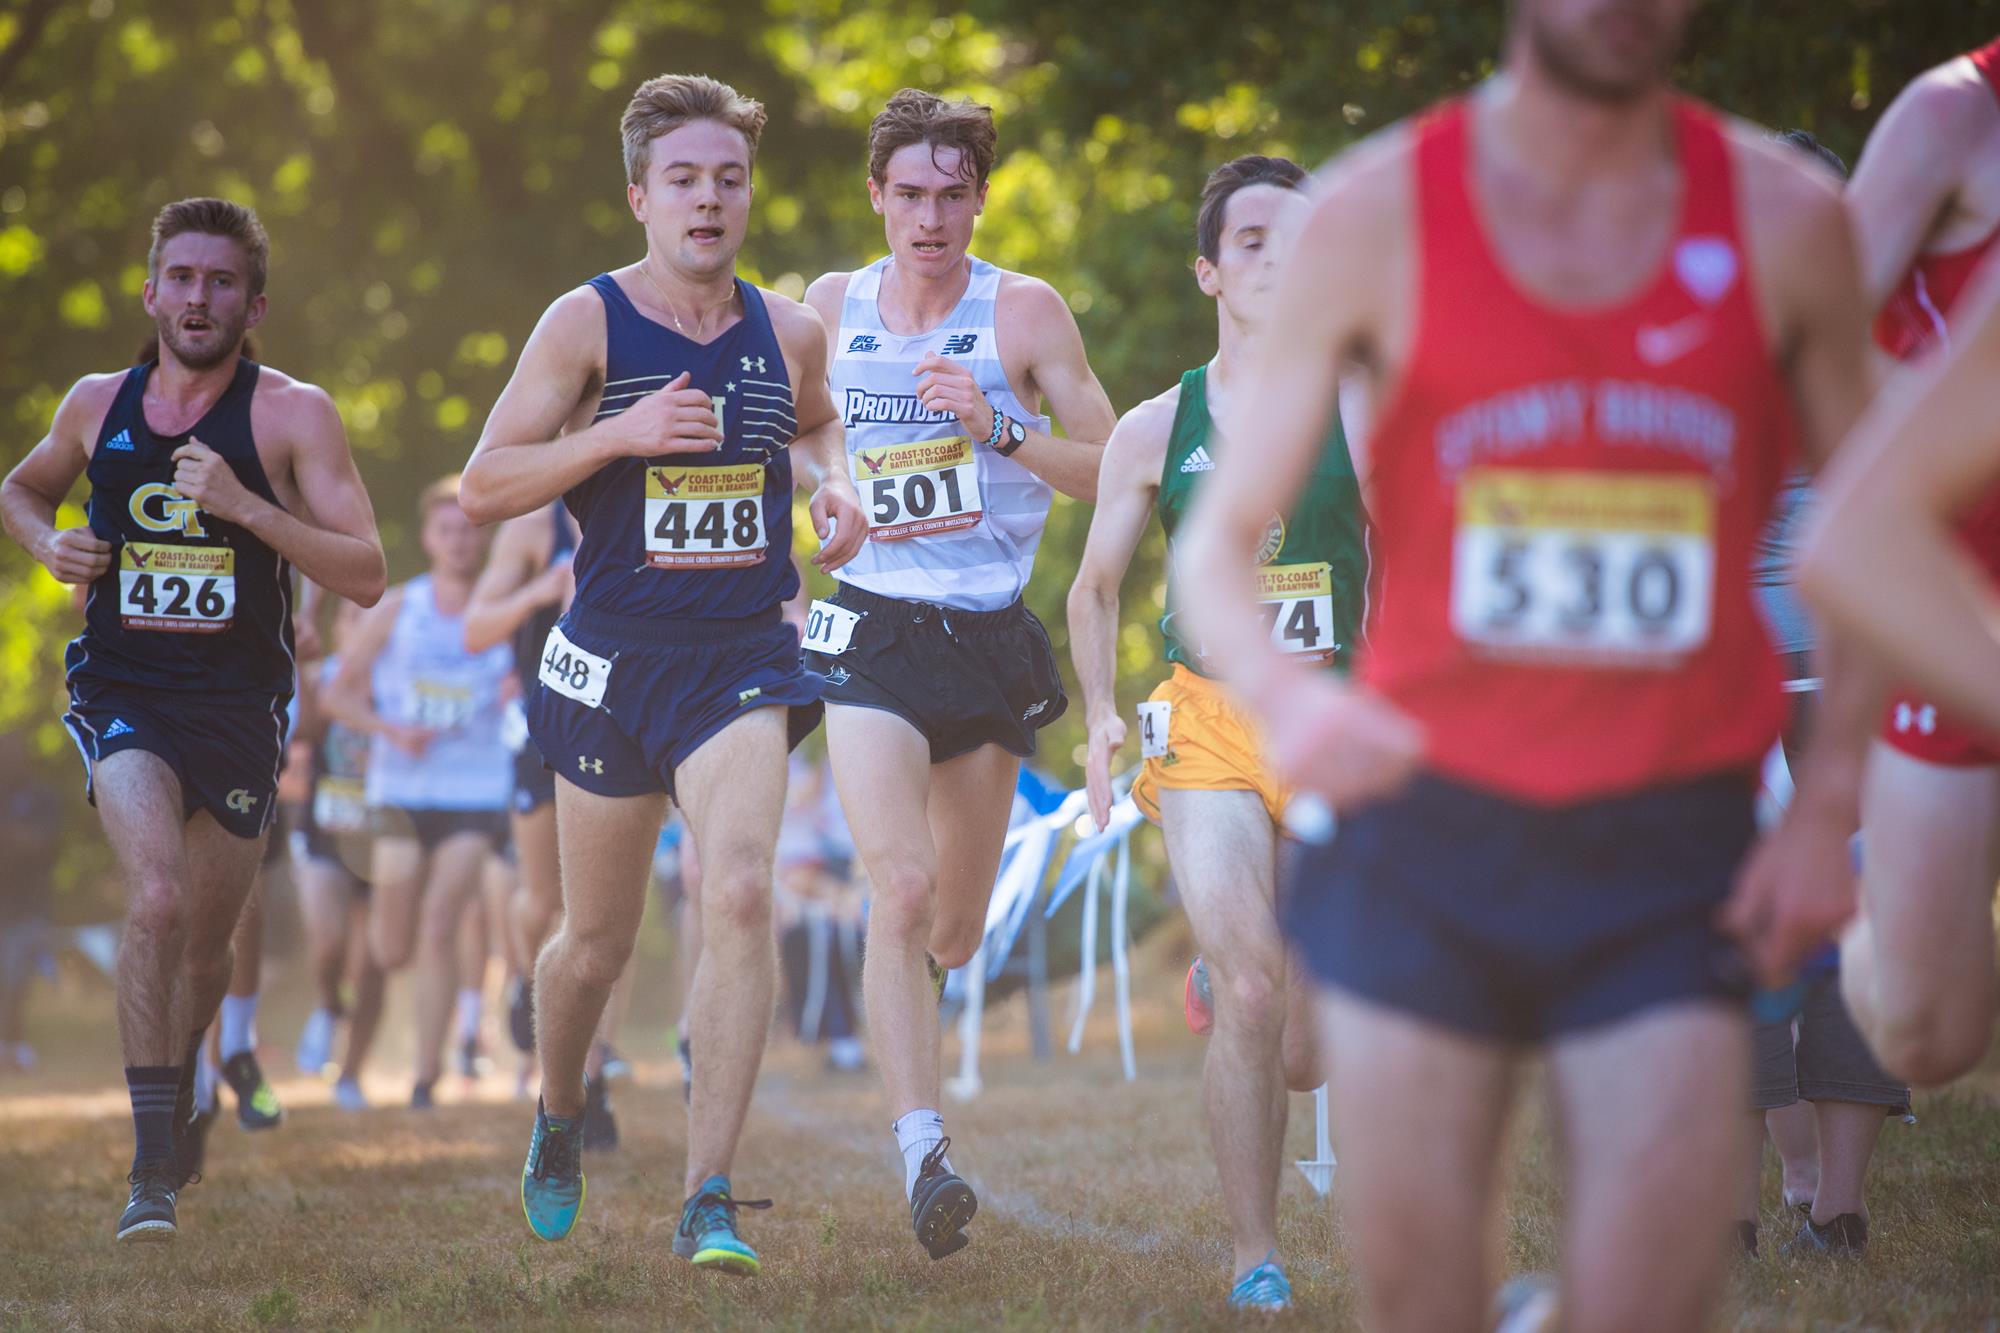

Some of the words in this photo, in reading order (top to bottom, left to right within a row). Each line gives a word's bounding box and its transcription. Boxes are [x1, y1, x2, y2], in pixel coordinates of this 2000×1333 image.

[849, 342, 881, 351] EAST
[853, 335, 876, 343] BIG
[890, 442, 963, 461] COAST-TO-COAST
[890, 460, 913, 469] BATTLE
[925, 451, 964, 465] BEANTOWN
[1180, 462, 1216, 473] adidas
[688, 472, 758, 484] COAST-TO-COAST
[688, 484, 713, 492] BATTLE
[725, 481, 759, 491] BEANTOWN
[873, 468, 963, 524] 501
[654, 500, 758, 549] 448
[155, 551, 225, 563] COAST-TO-COAST
[1256, 571, 1319, 584] ST-TO-COAST
[1277, 582, 1321, 593] BEANTOWN
[1489, 543, 1684, 636] 530
[128, 574, 226, 617] 426
[806, 609, 836, 643] 01
[544, 643, 590, 690] 448
